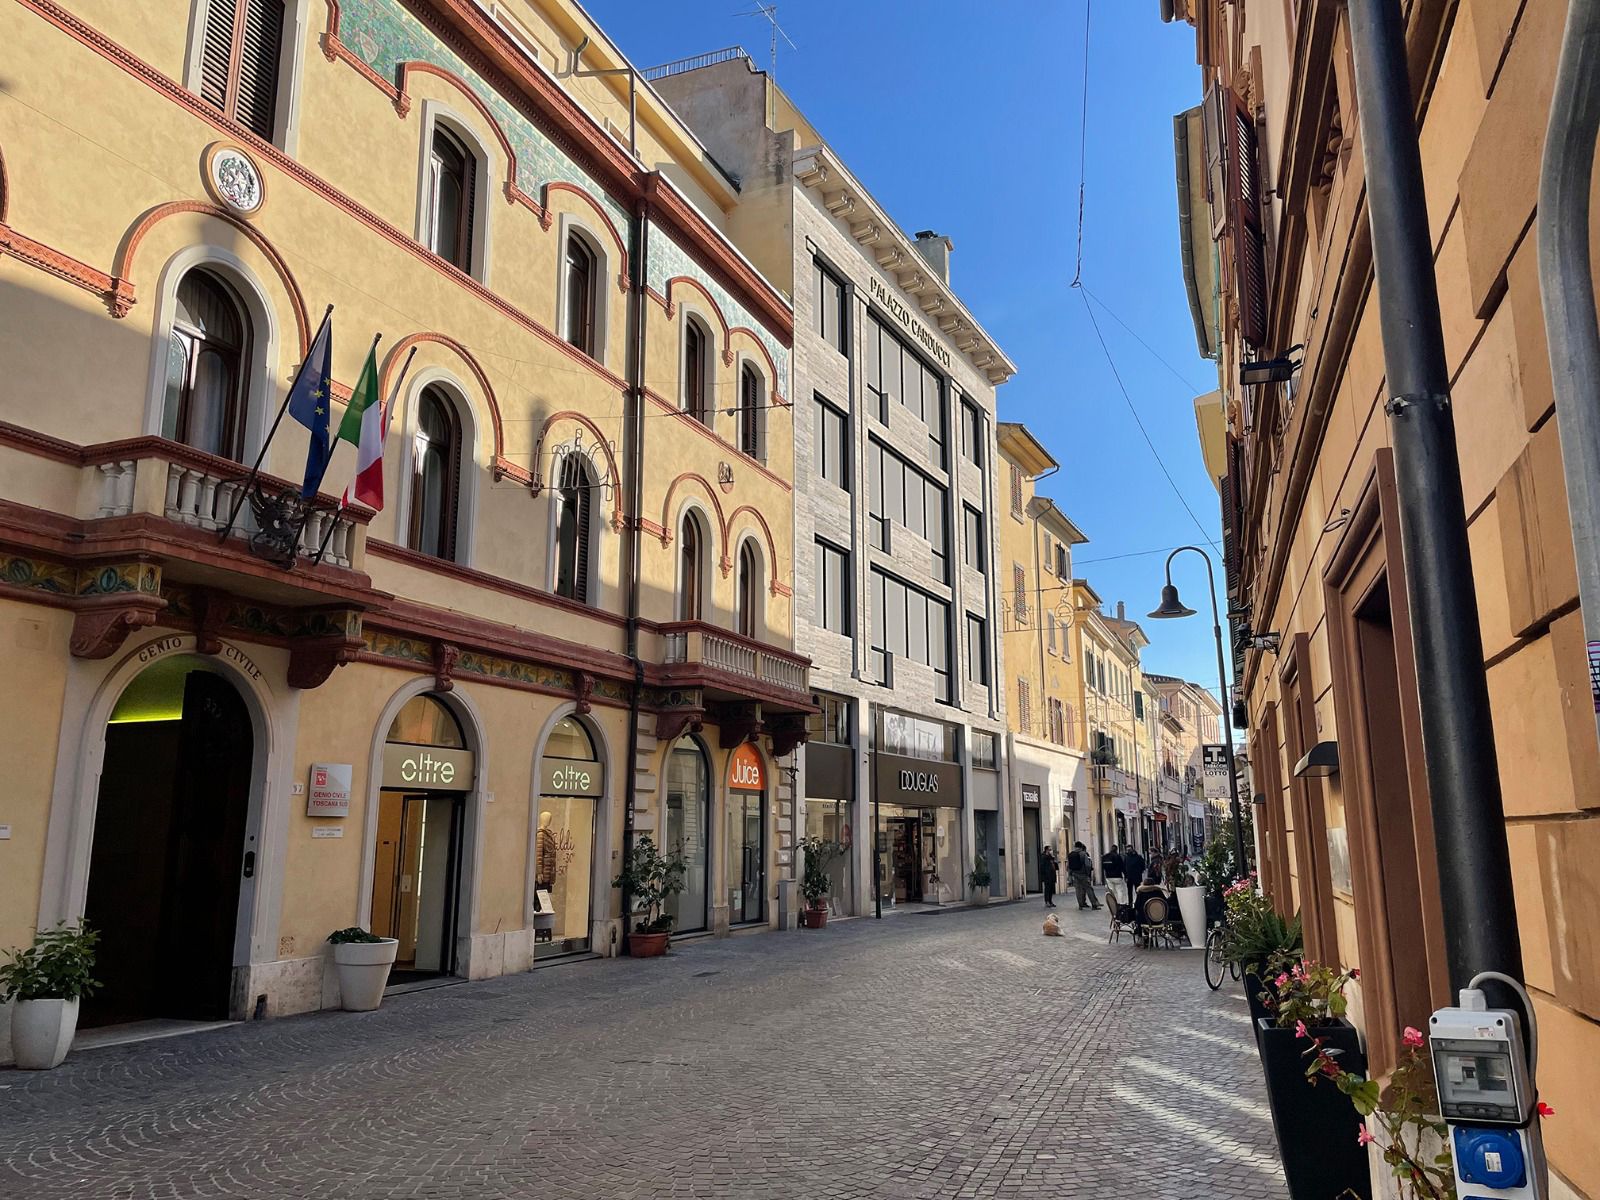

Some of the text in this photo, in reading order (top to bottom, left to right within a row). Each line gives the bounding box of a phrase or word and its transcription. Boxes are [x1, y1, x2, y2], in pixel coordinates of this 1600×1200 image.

[870, 276, 951, 368] PALAZZO CARDUCCI
[138, 637, 262, 681] GENIO CIVILE
[401, 753, 455, 784] oltre
[552, 765, 591, 791] oltre
[732, 758, 760, 785] Juice
[900, 770, 939, 793] DOUGLAS
[312, 800, 338, 808] TOSCANA
[313, 791, 347, 799] GENIO CIVILE
